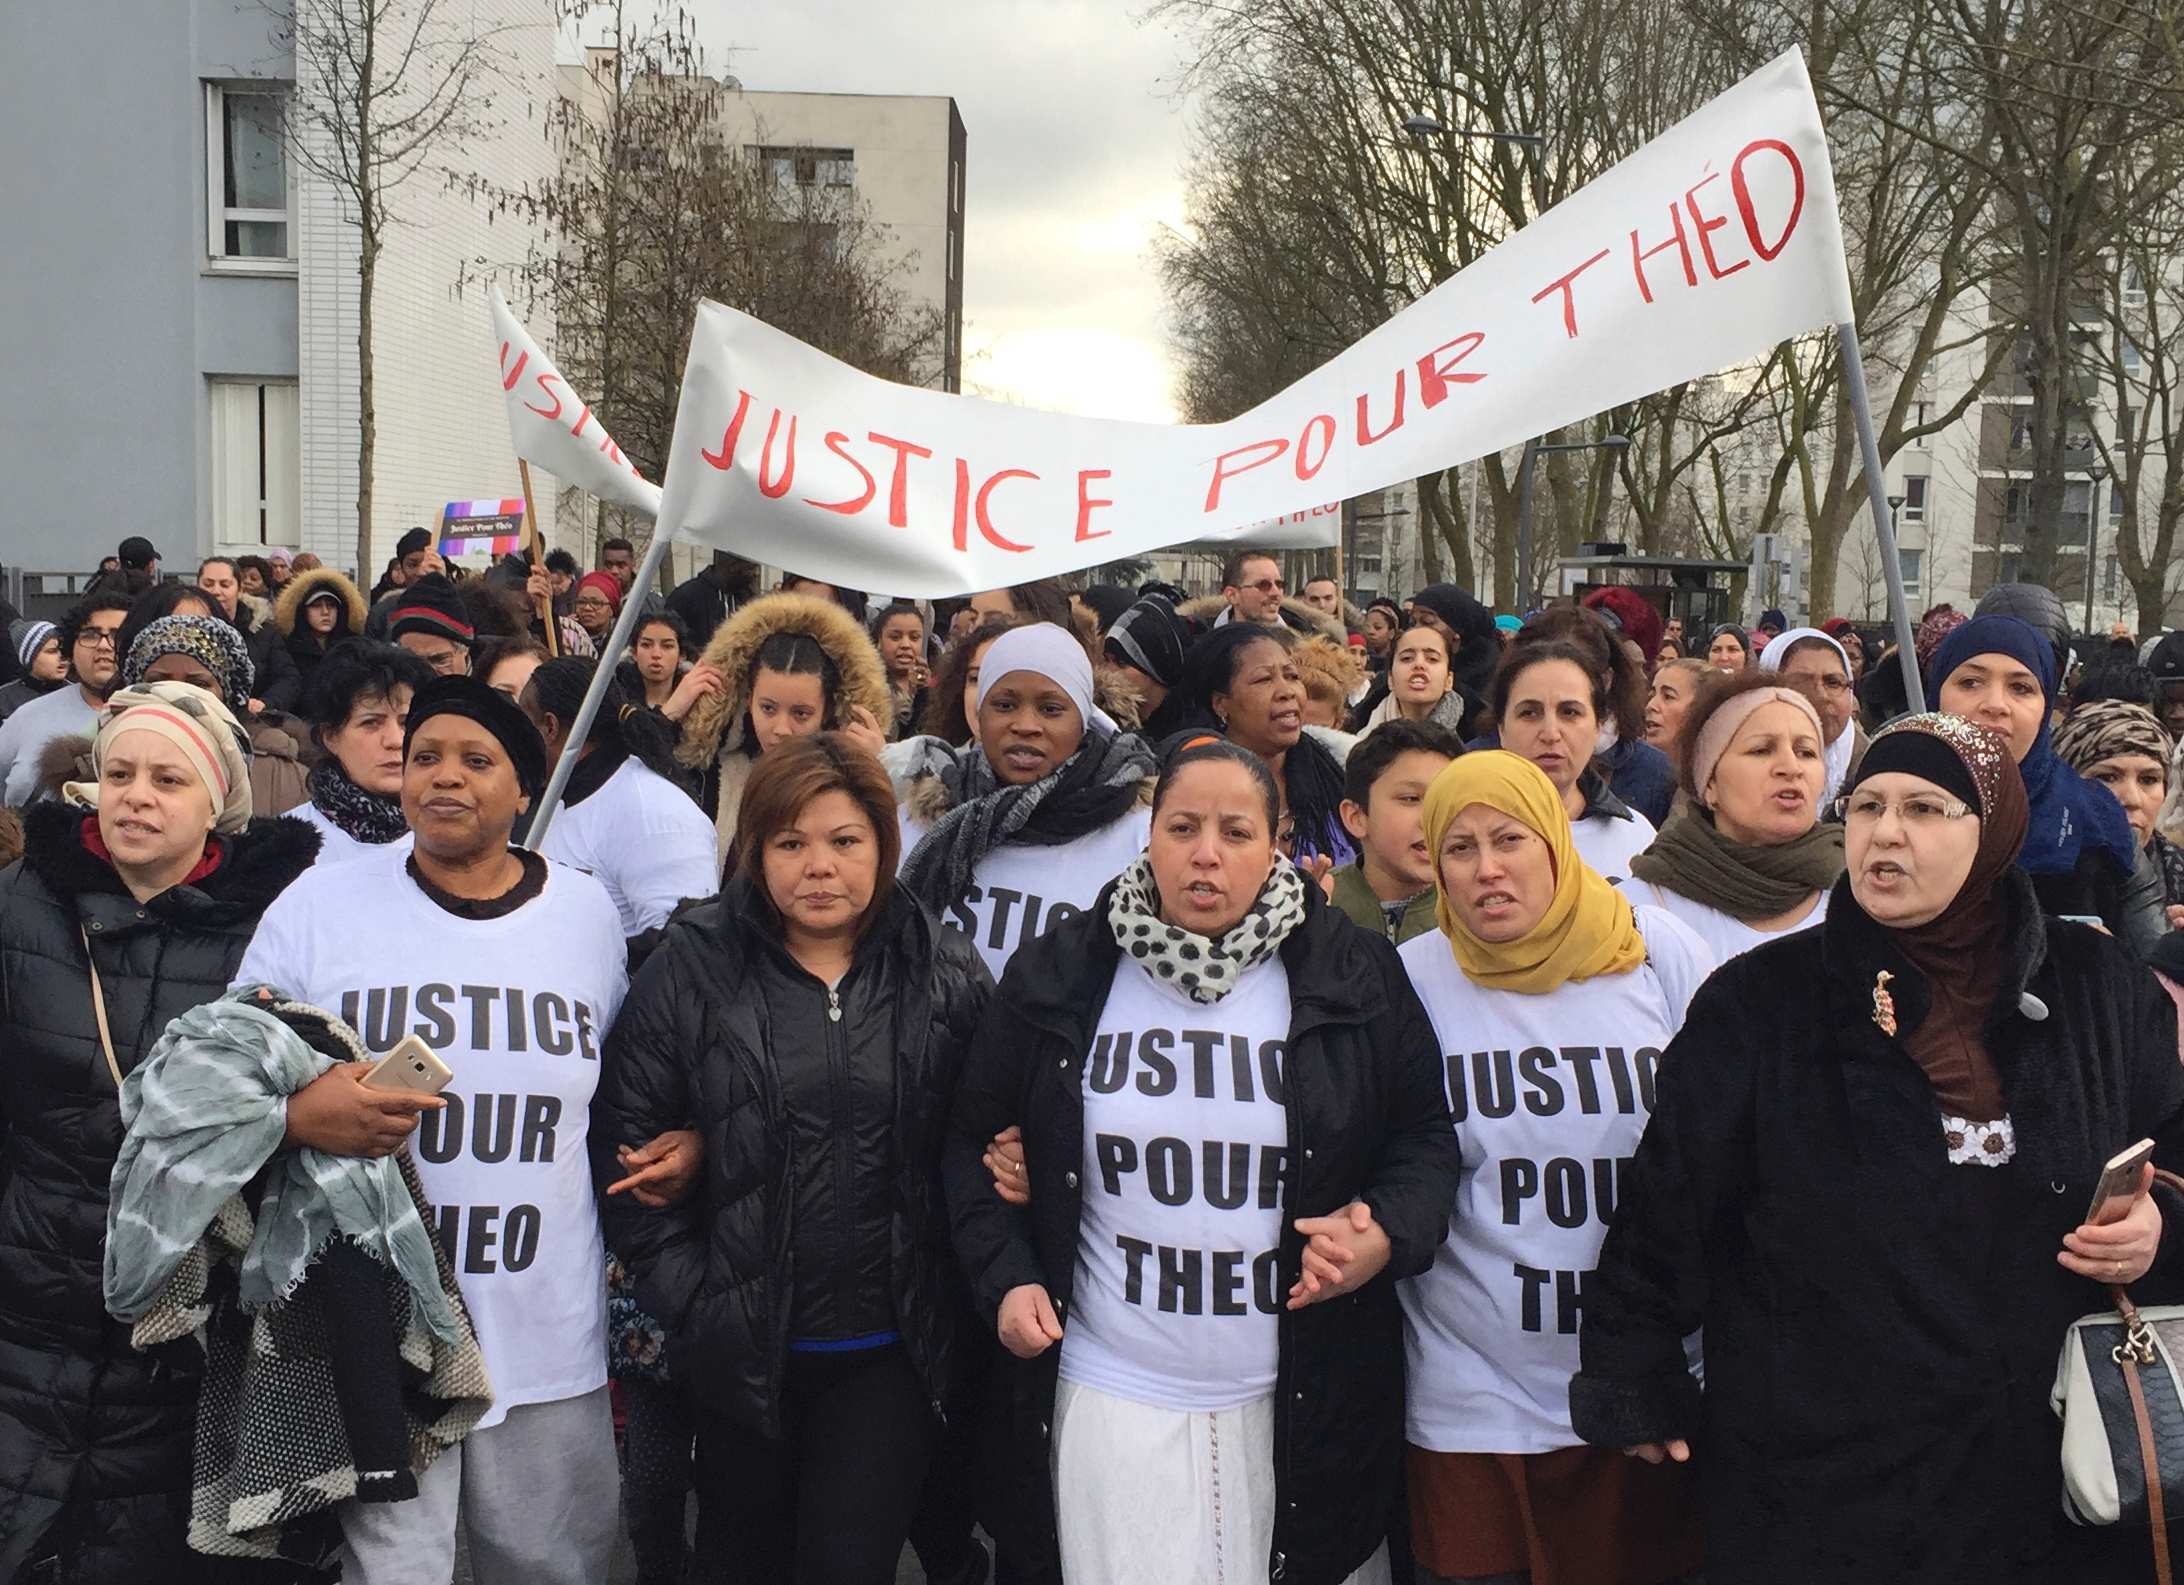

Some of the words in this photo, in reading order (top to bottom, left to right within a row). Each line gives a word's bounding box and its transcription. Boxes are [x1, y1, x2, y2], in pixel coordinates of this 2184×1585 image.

[701, 389, 1113, 553] JUSTICE
[1203, 332, 1488, 512] POUR
[1531, 139, 1806, 338] THÉO
[1089, 1027, 1287, 1106] USTIC
[418, 1090, 563, 1165] OUR
[1499, 1156, 1633, 1229] POU
[433, 1203, 542, 1275] HEO
[1513, 1262, 1593, 1335] TH
